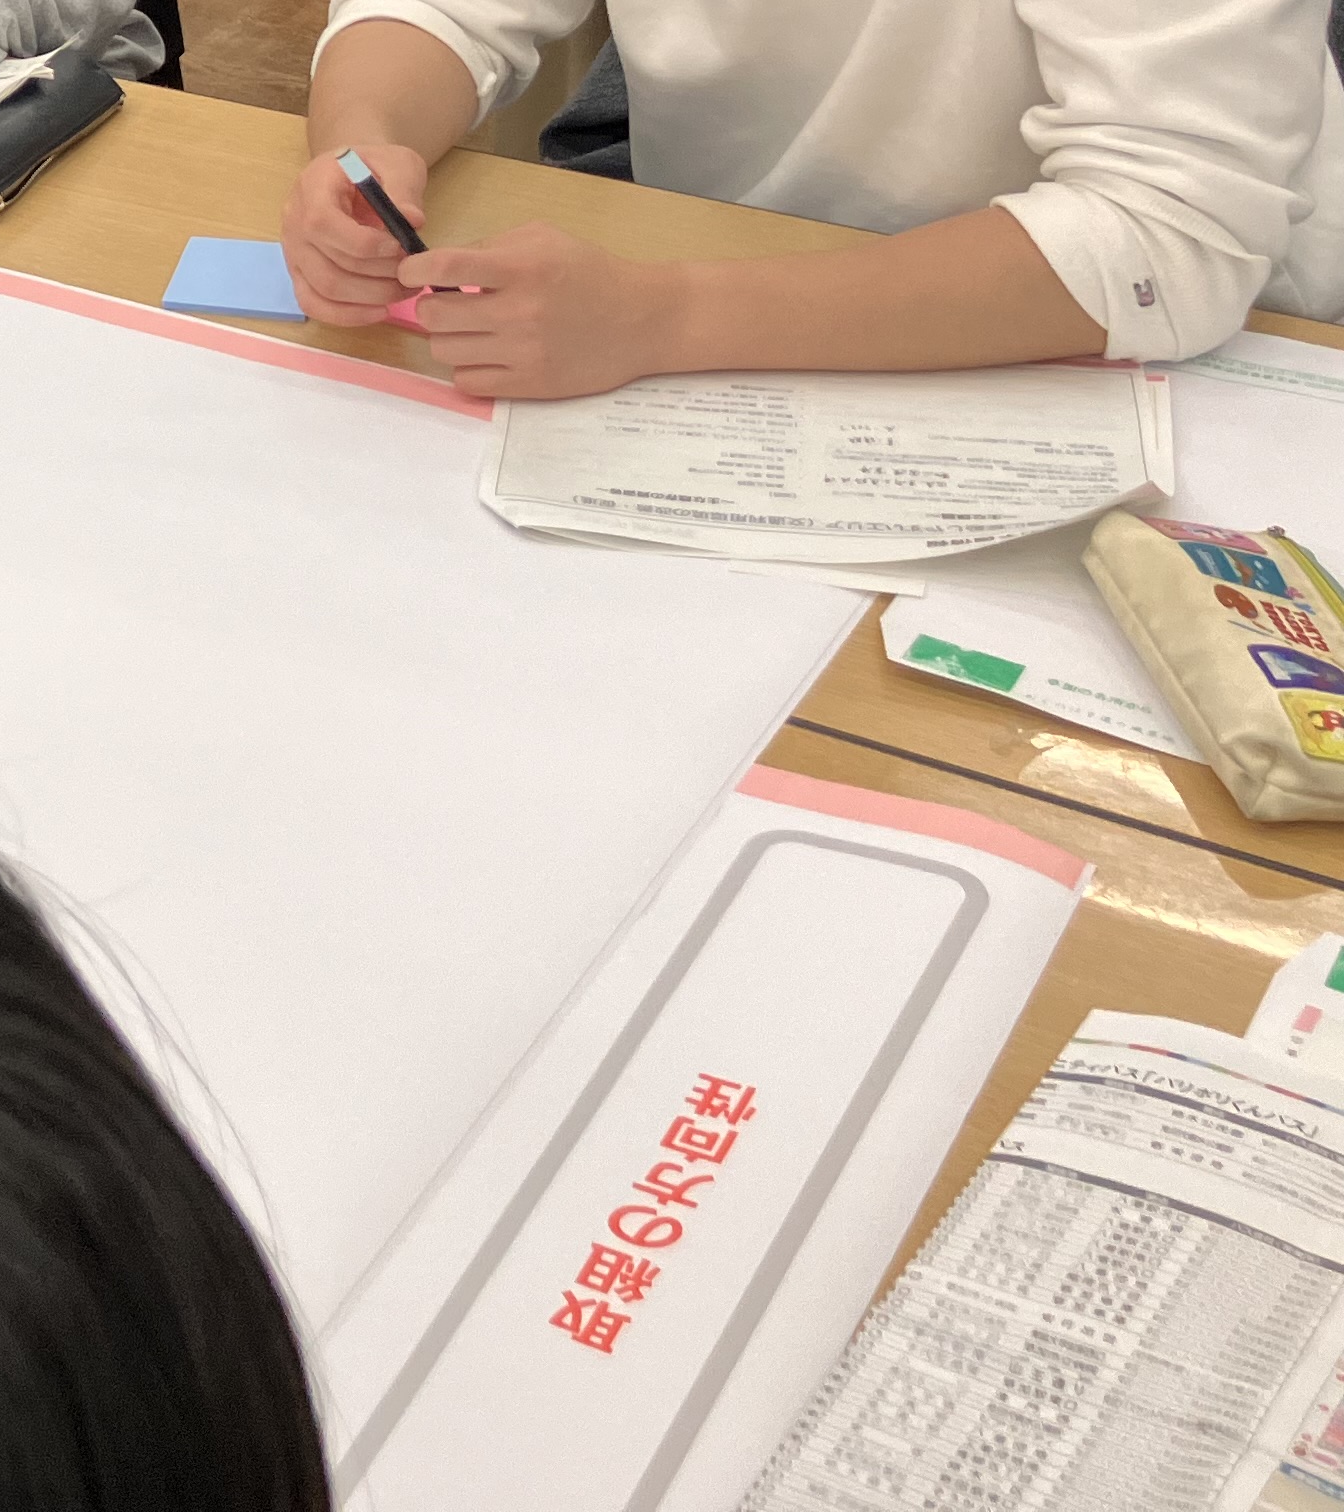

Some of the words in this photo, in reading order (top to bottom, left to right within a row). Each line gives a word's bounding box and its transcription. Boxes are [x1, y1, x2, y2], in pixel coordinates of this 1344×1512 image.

[549, 1072, 760, 1355] 取組の方向性
